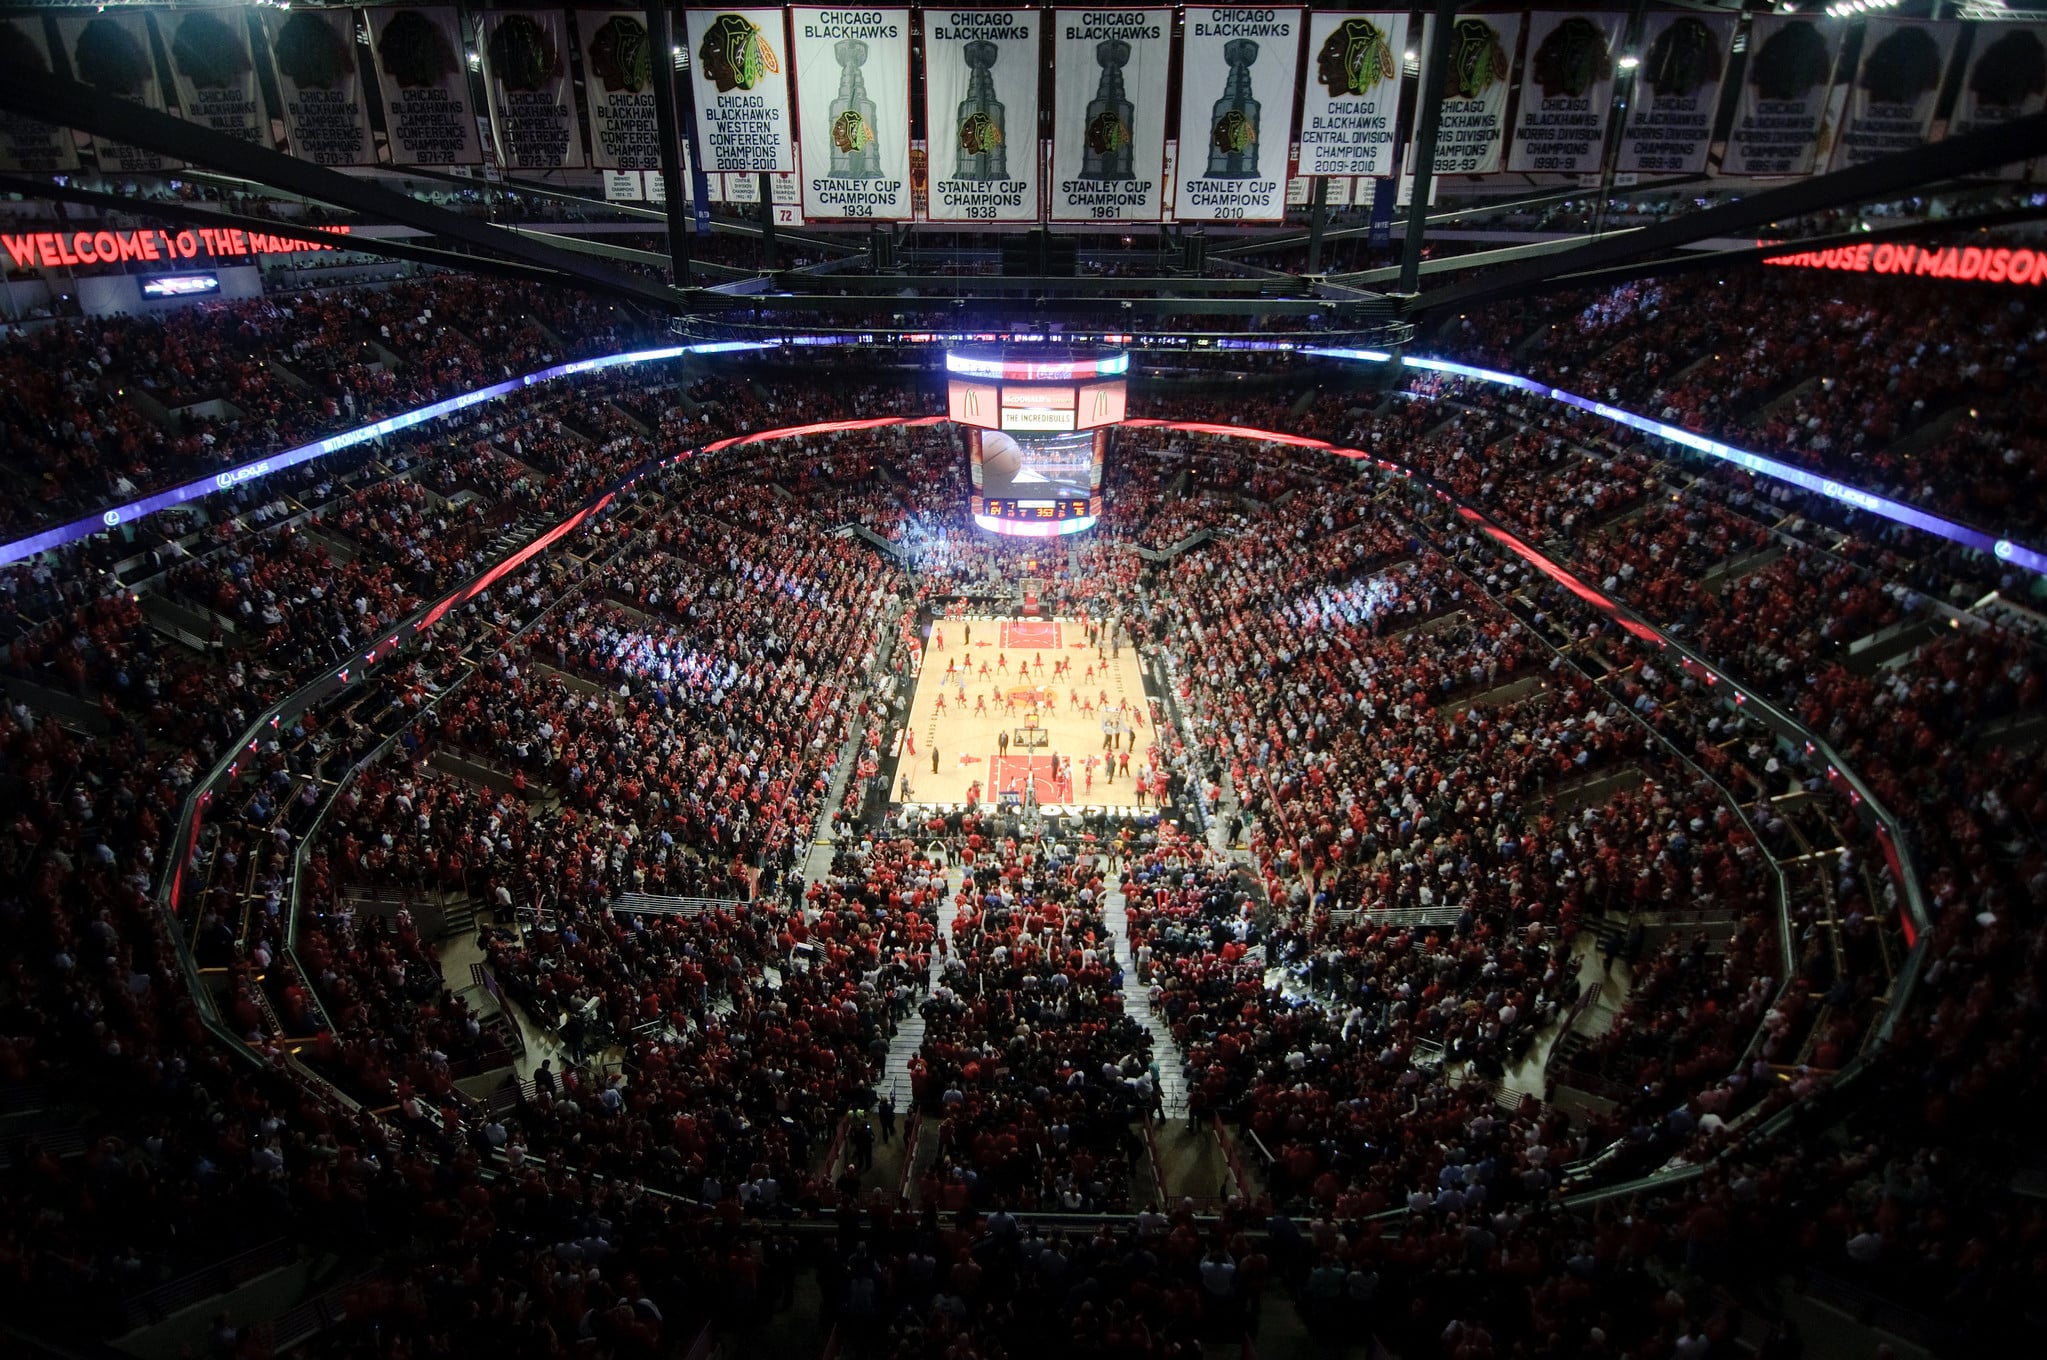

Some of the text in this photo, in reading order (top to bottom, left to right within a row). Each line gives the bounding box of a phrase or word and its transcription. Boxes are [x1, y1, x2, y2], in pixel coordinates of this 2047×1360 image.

[820, 12, 882, 24] CHICAGO
[951, 12, 1013, 26] CHICAGO
[1082, 12, 1145, 25] CHICAGO
[1212, 10, 1274, 22] CHICAGO
[805, 25, 898, 39] BLACKHAWKS
[935, 26, 1028, 40] BLACKHAWKS
[1066, 26, 1160, 40] BLACKHAWKS
[1195, 24, 1289, 36] BLACKHAWKS
[300, 91, 344, 102] CHICAGO
[403, 90, 448, 101] CHICAGO
[508, 94, 552, 105] CHICAGO
[609, 95, 654, 106] CHICAGO
[392, 102, 463, 114] BLACKHAWKS
[718, 96, 763, 108] CHICAGO
[1440, 101, 1485, 113] CHICAGO
[1542, 100, 1588, 111] CHICAGO
[190, 102, 256, 116] BLACKHAWKS
[289, 103, 358, 115] BLACKHAWKS
[498, 105, 568, 118] BLACKHAWKS
[598, 106, 654, 119] BLACKHAW
[707, 109, 779, 120] BLACKHAWKS
[1328, 103, 1375, 114] CHICAGO
[299, 117, 355, 128] CAMPBELL
[401, 115, 458, 126] CAMPBELL
[506, 119, 562, 130] CAMPBELL
[607, 120, 657, 131] CAMPBEL
[1313, 117, 1386, 129] BLACKHAWKS
[1438, 116, 1495, 128] ACKHAWKS
[1525, 114, 1598, 126] BLACKHAWKS
[1635, 113, 1706, 126] BLACKHAWKS
[397, 126, 466, 138] CONFERENCE
[717, 122, 770, 132] WESTERN
[295, 128, 364, 139] CONFERENCE
[503, 131, 569, 142] CONFERENCE
[601, 132, 658, 144] CONFEREN
[710, 134, 780, 145] CONFERENCE
[1303, 132, 1393, 143] CENTRAL DIVISION
[1456, 129, 1500, 142] DIVISION
[1517, 129, 1602, 140] NORRIS DIVISION
[1625, 128, 1709, 140] NORRIS DIVISION
[302, 140, 361, 151] CHAMPIONS
[404, 140, 464, 150] CHAMPIONS
[509, 143, 567, 154] CHAMPIONS
[607, 144, 660, 156] CHAMPION
[1434, 144, 1488, 156] HAMPIONS
[1527, 143, 1588, 154] CHAMPIONS
[1634, 142, 1694, 155] CHAMPIONS
[314, 152, 354, 164] 1970-71
[417, 152, 455, 162] 1971-72
[716, 147, 776, 157] CHAMPIONS
[1316, 147, 1377, 158] CHAMPIONS
[519, 156, 561, 166] 1972-73
[618, 157, 658, 168] 1991-92
[718, 159, 776, 169] 2009-2010
[1315, 161, 1374, 172] 2009-2010
[1435, 159, 1476, 171] 992-93
[1534, 158, 1576, 168] 1990-91
[813, 180, 901, 193] STANLEY CUP
[937, 181, 1027, 194] STANLEY CUP
[1062, 181, 1152, 193] STANLEY CUP
[1186, 182, 1243, 193] STANLEY
[1249, 182, 1276, 192] CUP
[820, 192, 896, 205] CHAMPIONS
[944, 194, 1021, 206] CHAMPIONS
[1068, 194, 1146, 205] CHAMPIONS
[1192, 195, 1270, 206] CHAMPIONS
[781, 210, 792, 221] 72
[843, 205, 872, 217] 1934
[966, 206, 997, 218] 1938
[1092, 207, 1121, 218] 1961
[1214, 207, 1243, 219] 2010
[2, 229, 158, 267] WELCOME
[160, 229, 197, 258] TO
[200, 228, 246, 256] THE
[1873, 243, 1916, 274] ON
[231, 462, 269, 481] LEXUS
